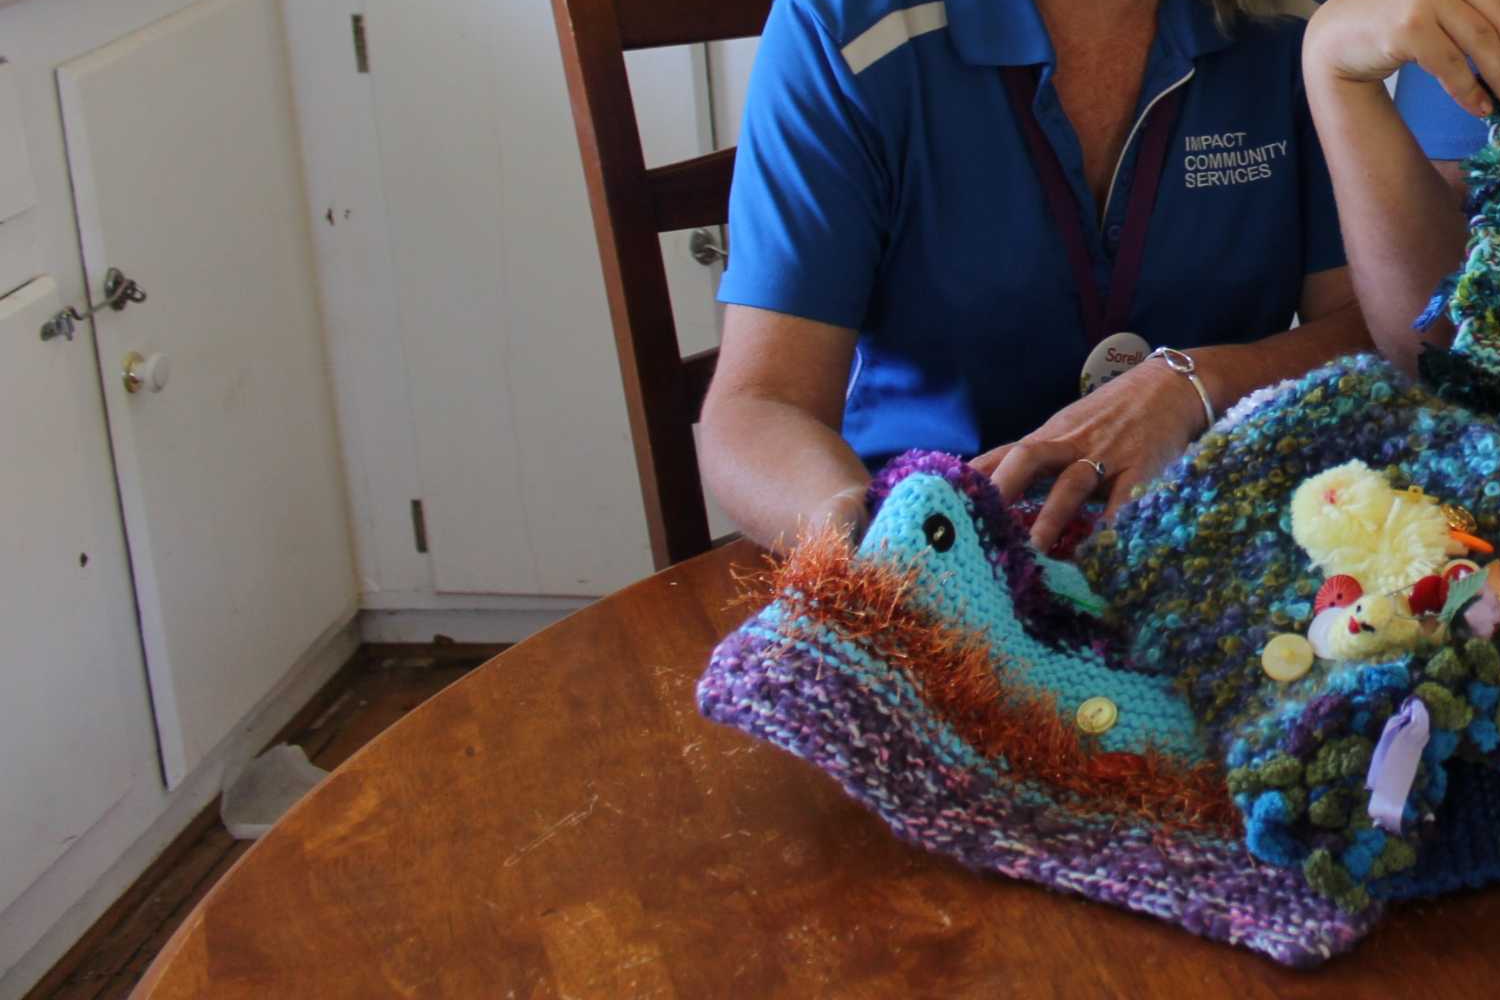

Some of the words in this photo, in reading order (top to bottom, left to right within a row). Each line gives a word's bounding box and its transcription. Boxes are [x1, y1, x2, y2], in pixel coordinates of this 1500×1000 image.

[1184, 131, 1247, 151] IMPACT
[1184, 139, 1288, 171] COMMUNITY
[1184, 162, 1273, 188] SERVICES
